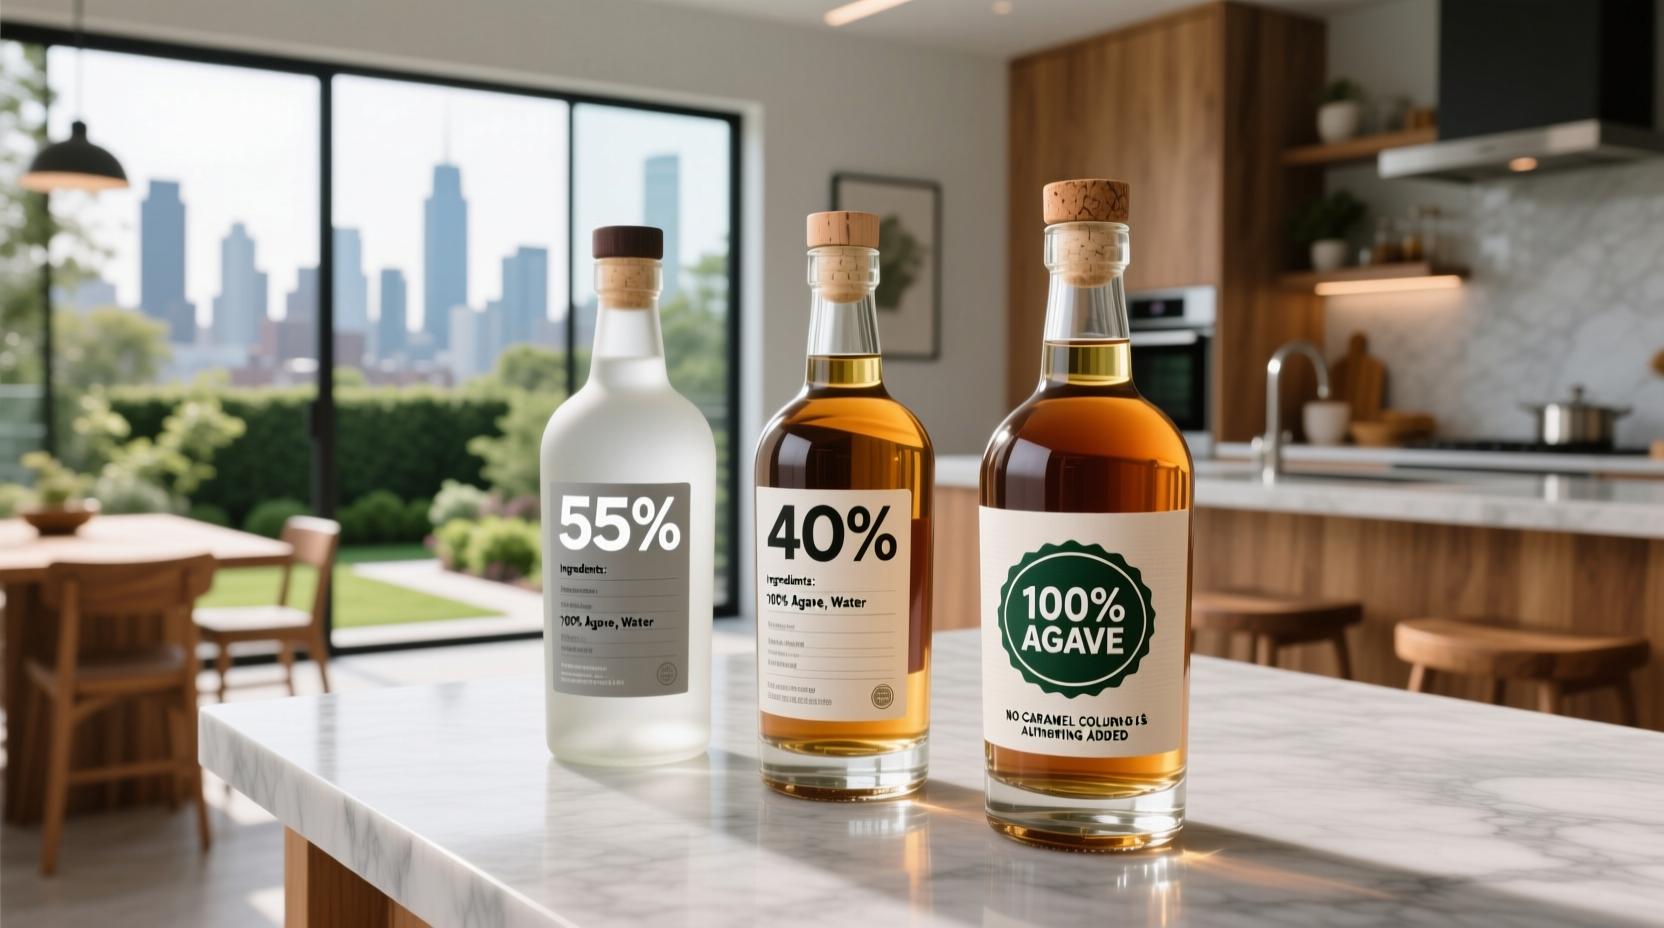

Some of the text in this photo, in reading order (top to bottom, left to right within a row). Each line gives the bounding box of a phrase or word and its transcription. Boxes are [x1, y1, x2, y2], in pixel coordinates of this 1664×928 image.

[559, 495, 681, 551] 55%
[767, 504, 897, 562] 40%
[831, 596, 867, 608] Water
[1022, 585, 1126, 622] 100%
[621, 616, 654, 628] Water
[1021, 624, 1124, 655] AGAVE
[1006, 709, 1020, 721] NO
[1021, 711, 1075, 727] CARAMEL
[1086, 729, 1129, 742] ADDED
